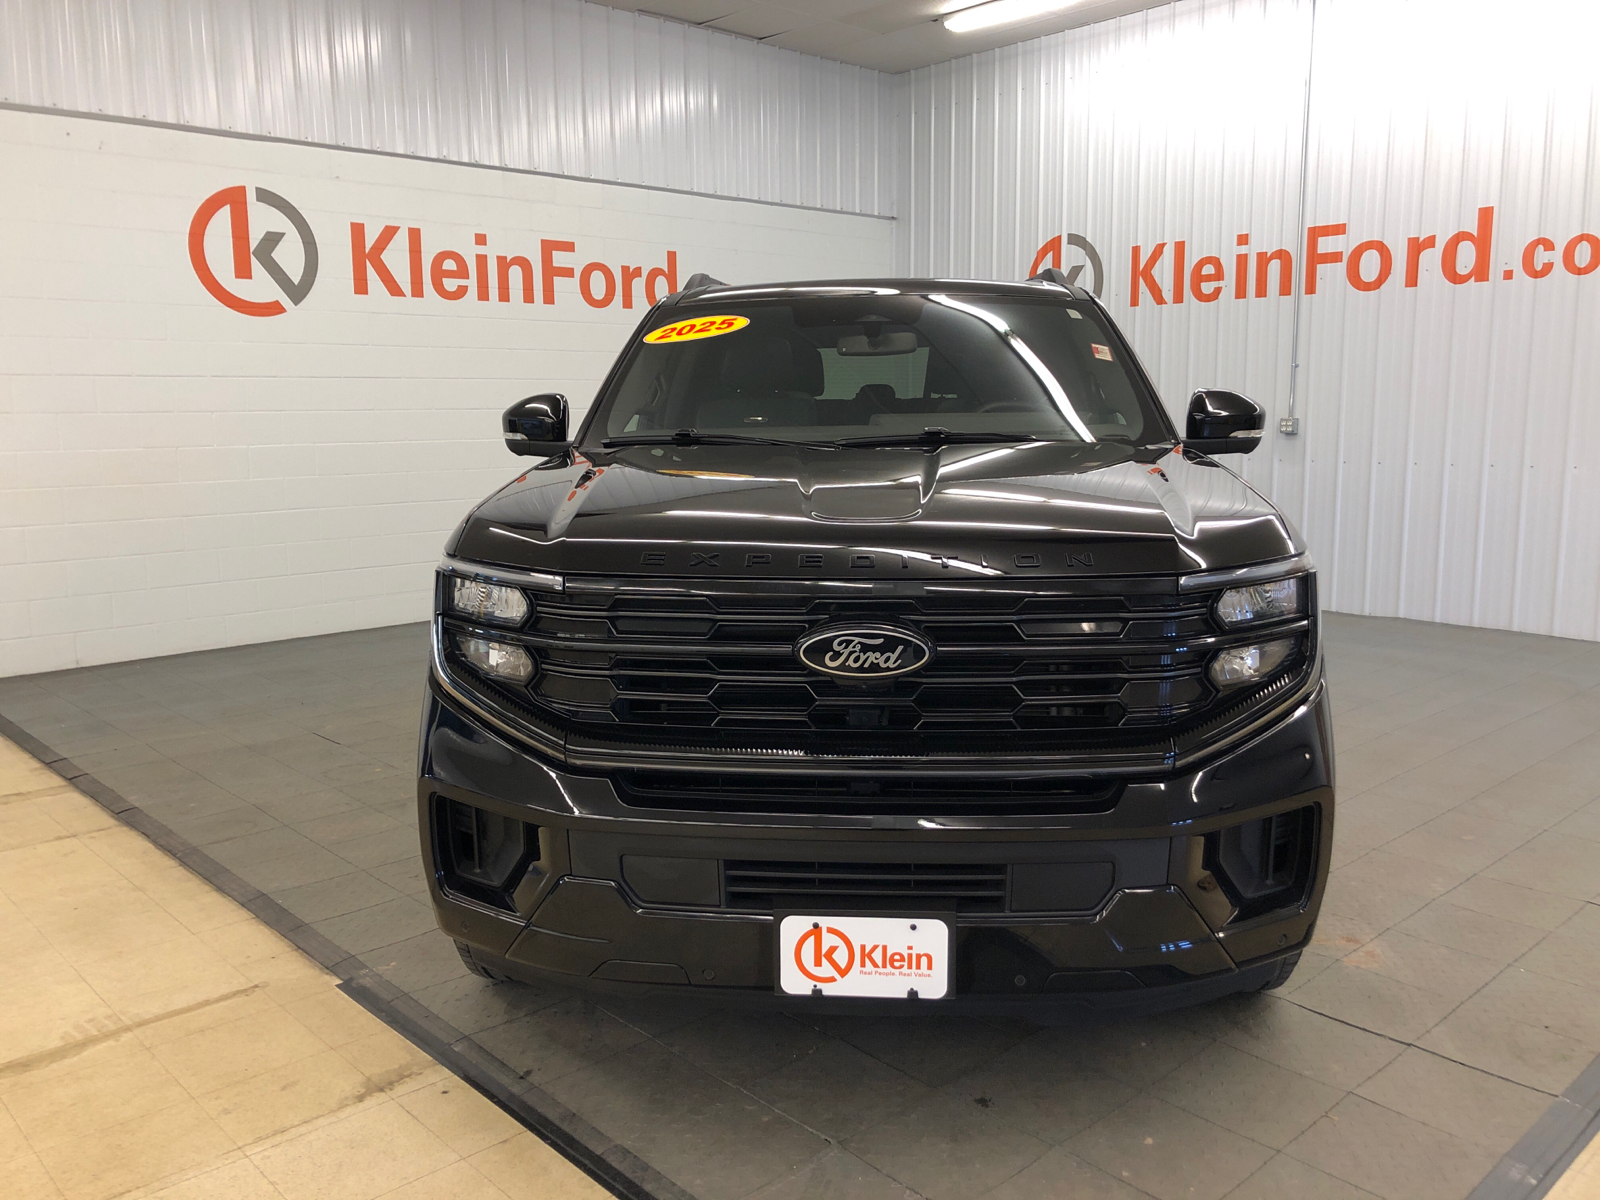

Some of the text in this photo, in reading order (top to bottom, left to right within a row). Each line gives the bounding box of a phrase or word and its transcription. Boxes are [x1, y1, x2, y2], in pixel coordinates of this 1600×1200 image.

[653, 317, 739, 341] 2025
[639, 551, 1094, 569] EXPEDITION
[824, 636, 904, 669] Ford
[859, 943, 933, 971] Klein
